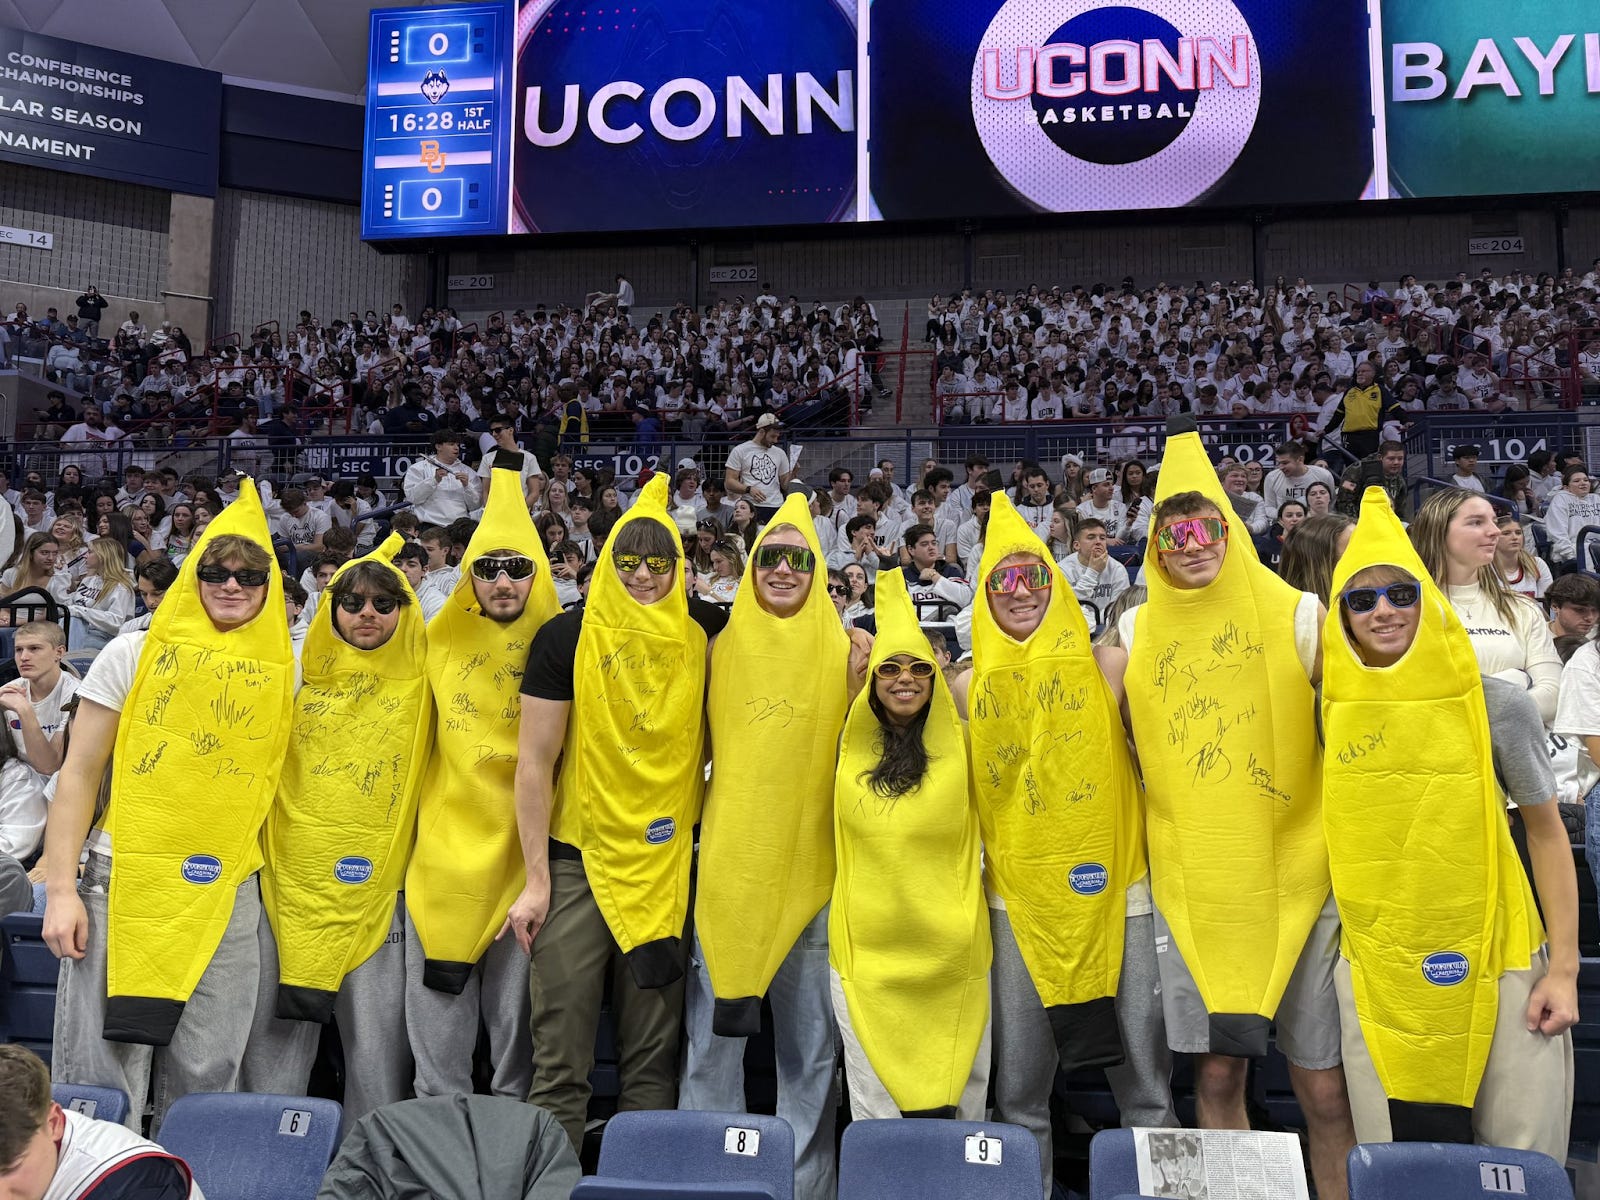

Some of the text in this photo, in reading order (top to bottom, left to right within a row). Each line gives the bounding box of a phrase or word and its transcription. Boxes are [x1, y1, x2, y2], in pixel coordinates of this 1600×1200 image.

[428, 33, 449, 56] 0
[7, 51, 132, 87] CONFERENCE
[982, 34, 1250, 100] UCONN
[390, 107, 485, 132] 16:28 1ST
[523, 70, 855, 147] UCONN
[51, 106, 142, 136] SEASON
[457, 119, 491, 131] HALF
[421, 187, 443, 211] 0
[1470, 239, 1523, 251] SEC 204
[448, 276, 494, 288] SEC 201
[711, 268, 757, 280] SEC 202
[342, 461, 371, 473] SEC
[382, 456, 424, 477] 10
[574, 455, 660, 475] SEC 102
[289, 1112, 301, 1133] 6
[737, 1131, 746, 1153] 8
[979, 1139, 989, 1162] 9
[1491, 1167, 1511, 1191] 11
